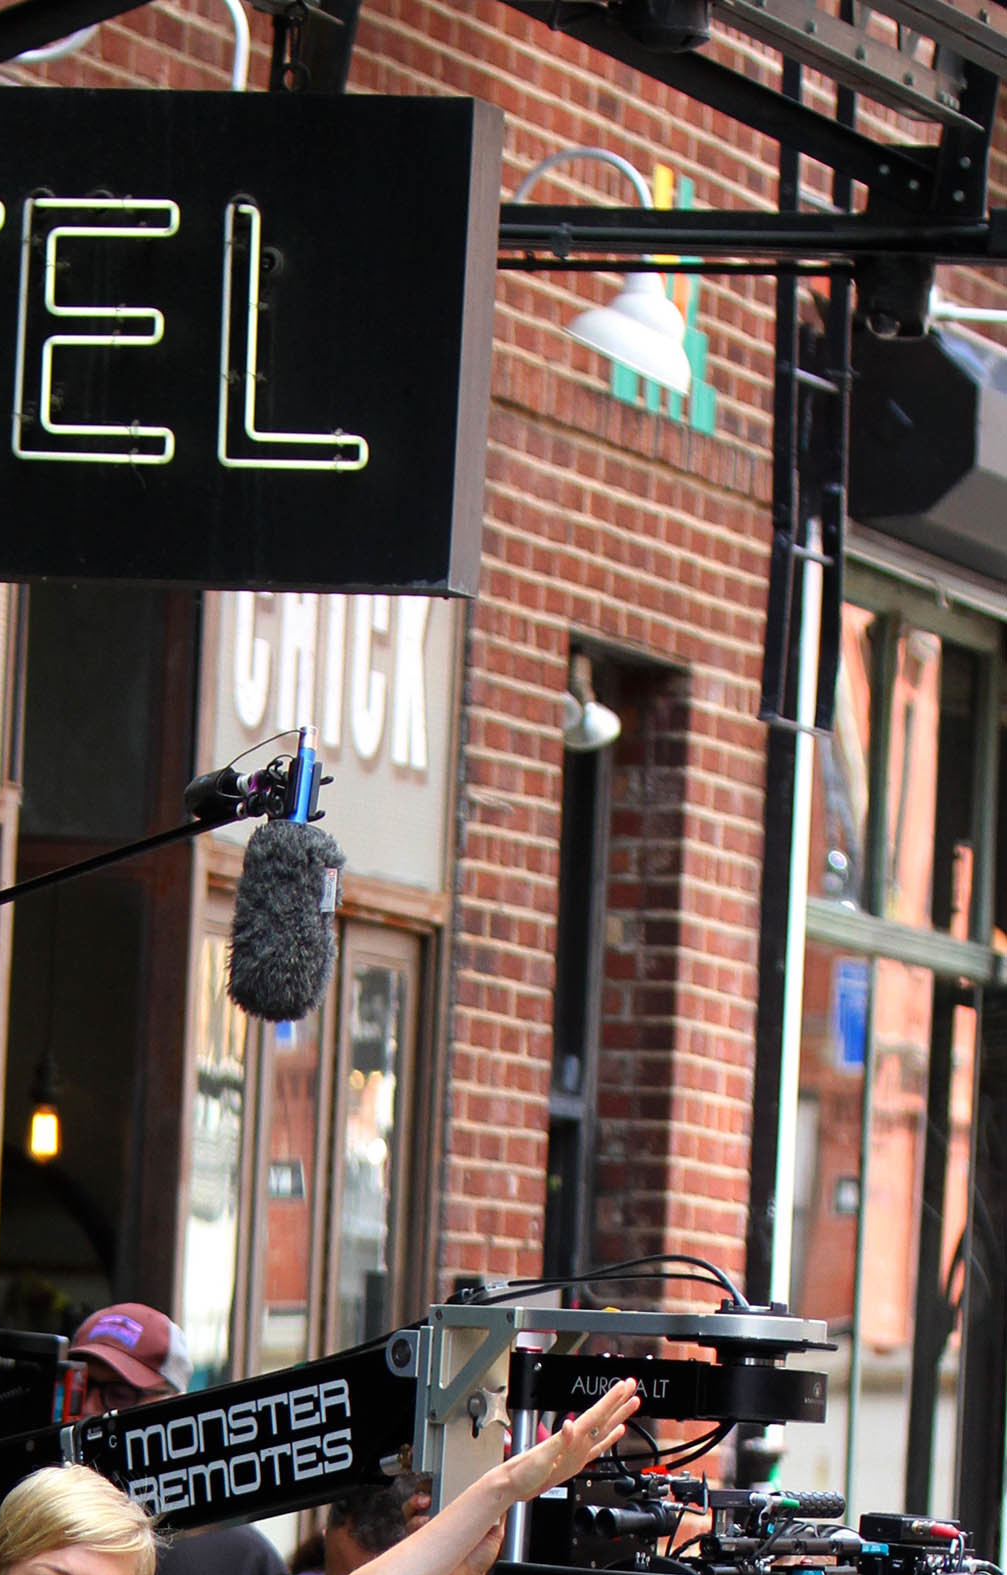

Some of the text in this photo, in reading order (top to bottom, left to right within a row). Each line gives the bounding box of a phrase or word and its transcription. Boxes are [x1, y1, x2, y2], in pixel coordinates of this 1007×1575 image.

[233, 590, 429, 771] CHICK
[124, 1378, 352, 1471] MONSTER
[653, 1379, 670, 1399] LT
[108, 1434, 119, 1448] C
[127, 1427, 354, 1514] REMOTES
